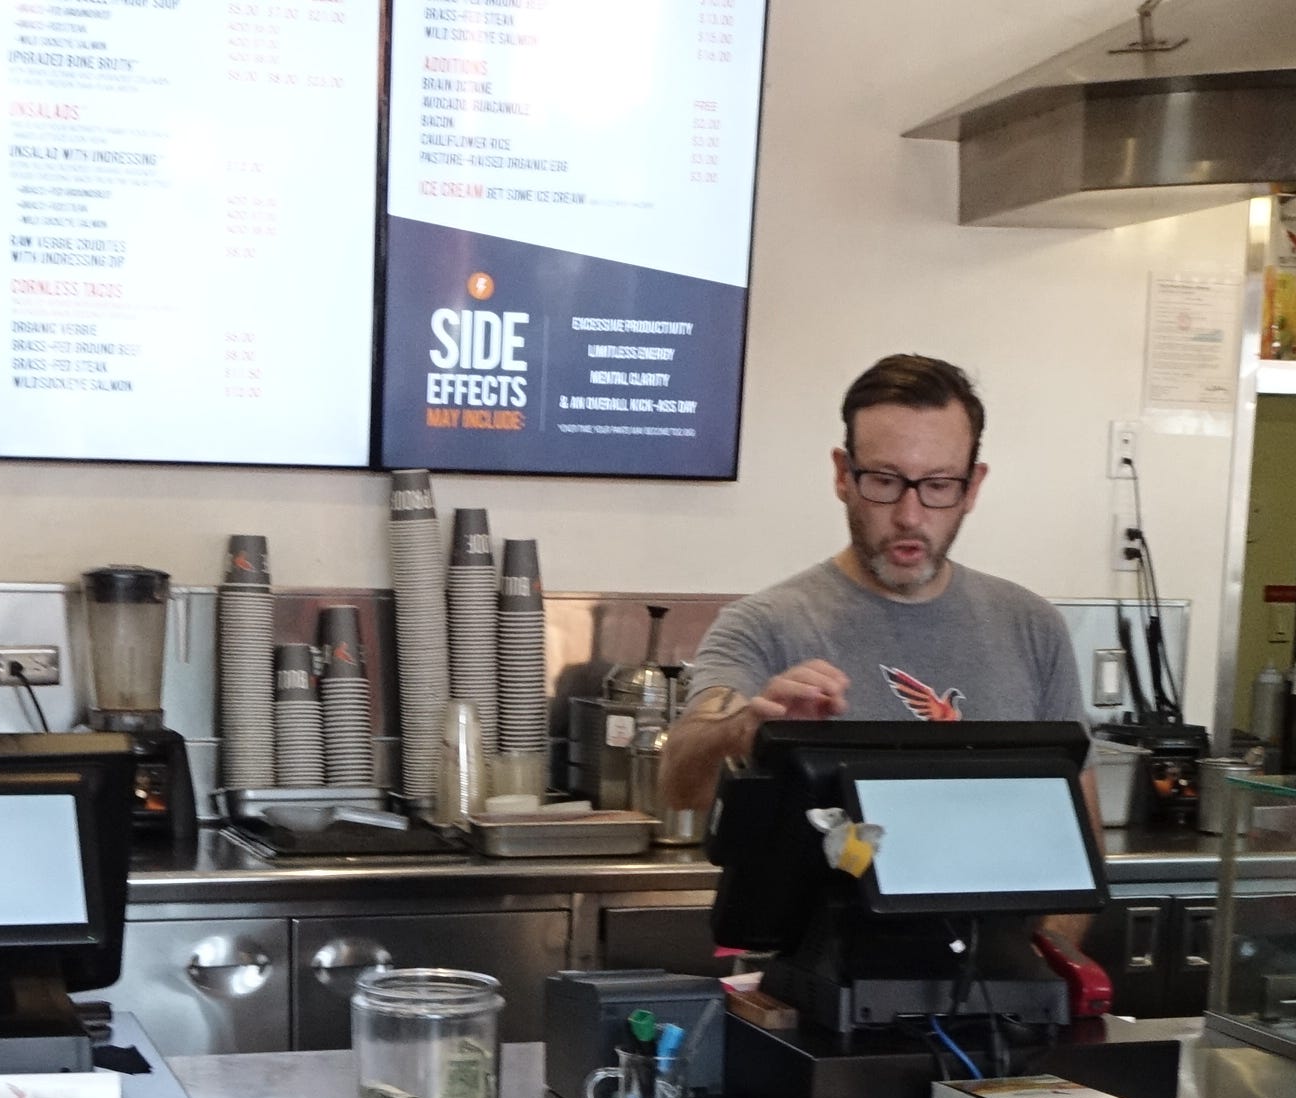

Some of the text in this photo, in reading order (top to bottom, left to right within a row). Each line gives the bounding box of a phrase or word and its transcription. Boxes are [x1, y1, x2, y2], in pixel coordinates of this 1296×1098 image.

[429, 307, 530, 372] SIDE
[426, 372, 528, 409] EFFECTS
[589, 370, 629, 386] MENTAL
[426, 408, 459, 429] MAY
